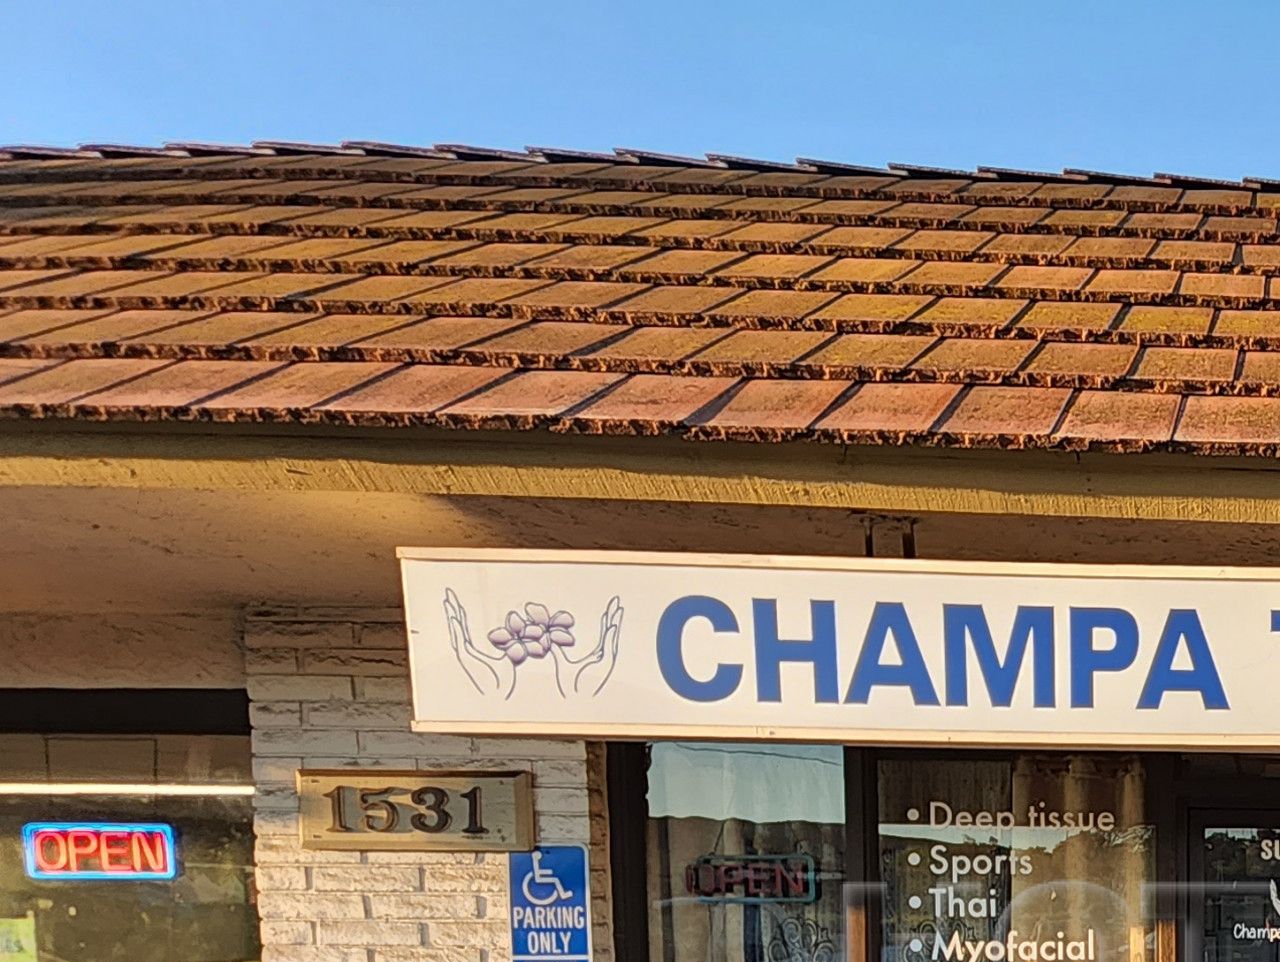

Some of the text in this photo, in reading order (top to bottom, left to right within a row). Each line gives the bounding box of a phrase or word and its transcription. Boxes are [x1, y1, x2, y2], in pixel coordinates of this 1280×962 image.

[655, 593, 1231, 712] CHAMPA
[321, 785, 491, 835] 1531
[929, 802, 1116, 833] Deep tissue
[33, 830, 166, 873] OPEN
[929, 845, 1034, 883] Sports
[685, 862, 805, 897] OPEN
[513, 906, 585, 929] PARKING
[927, 886, 1000, 919] Thai
[527, 931, 572, 954] ONLY
